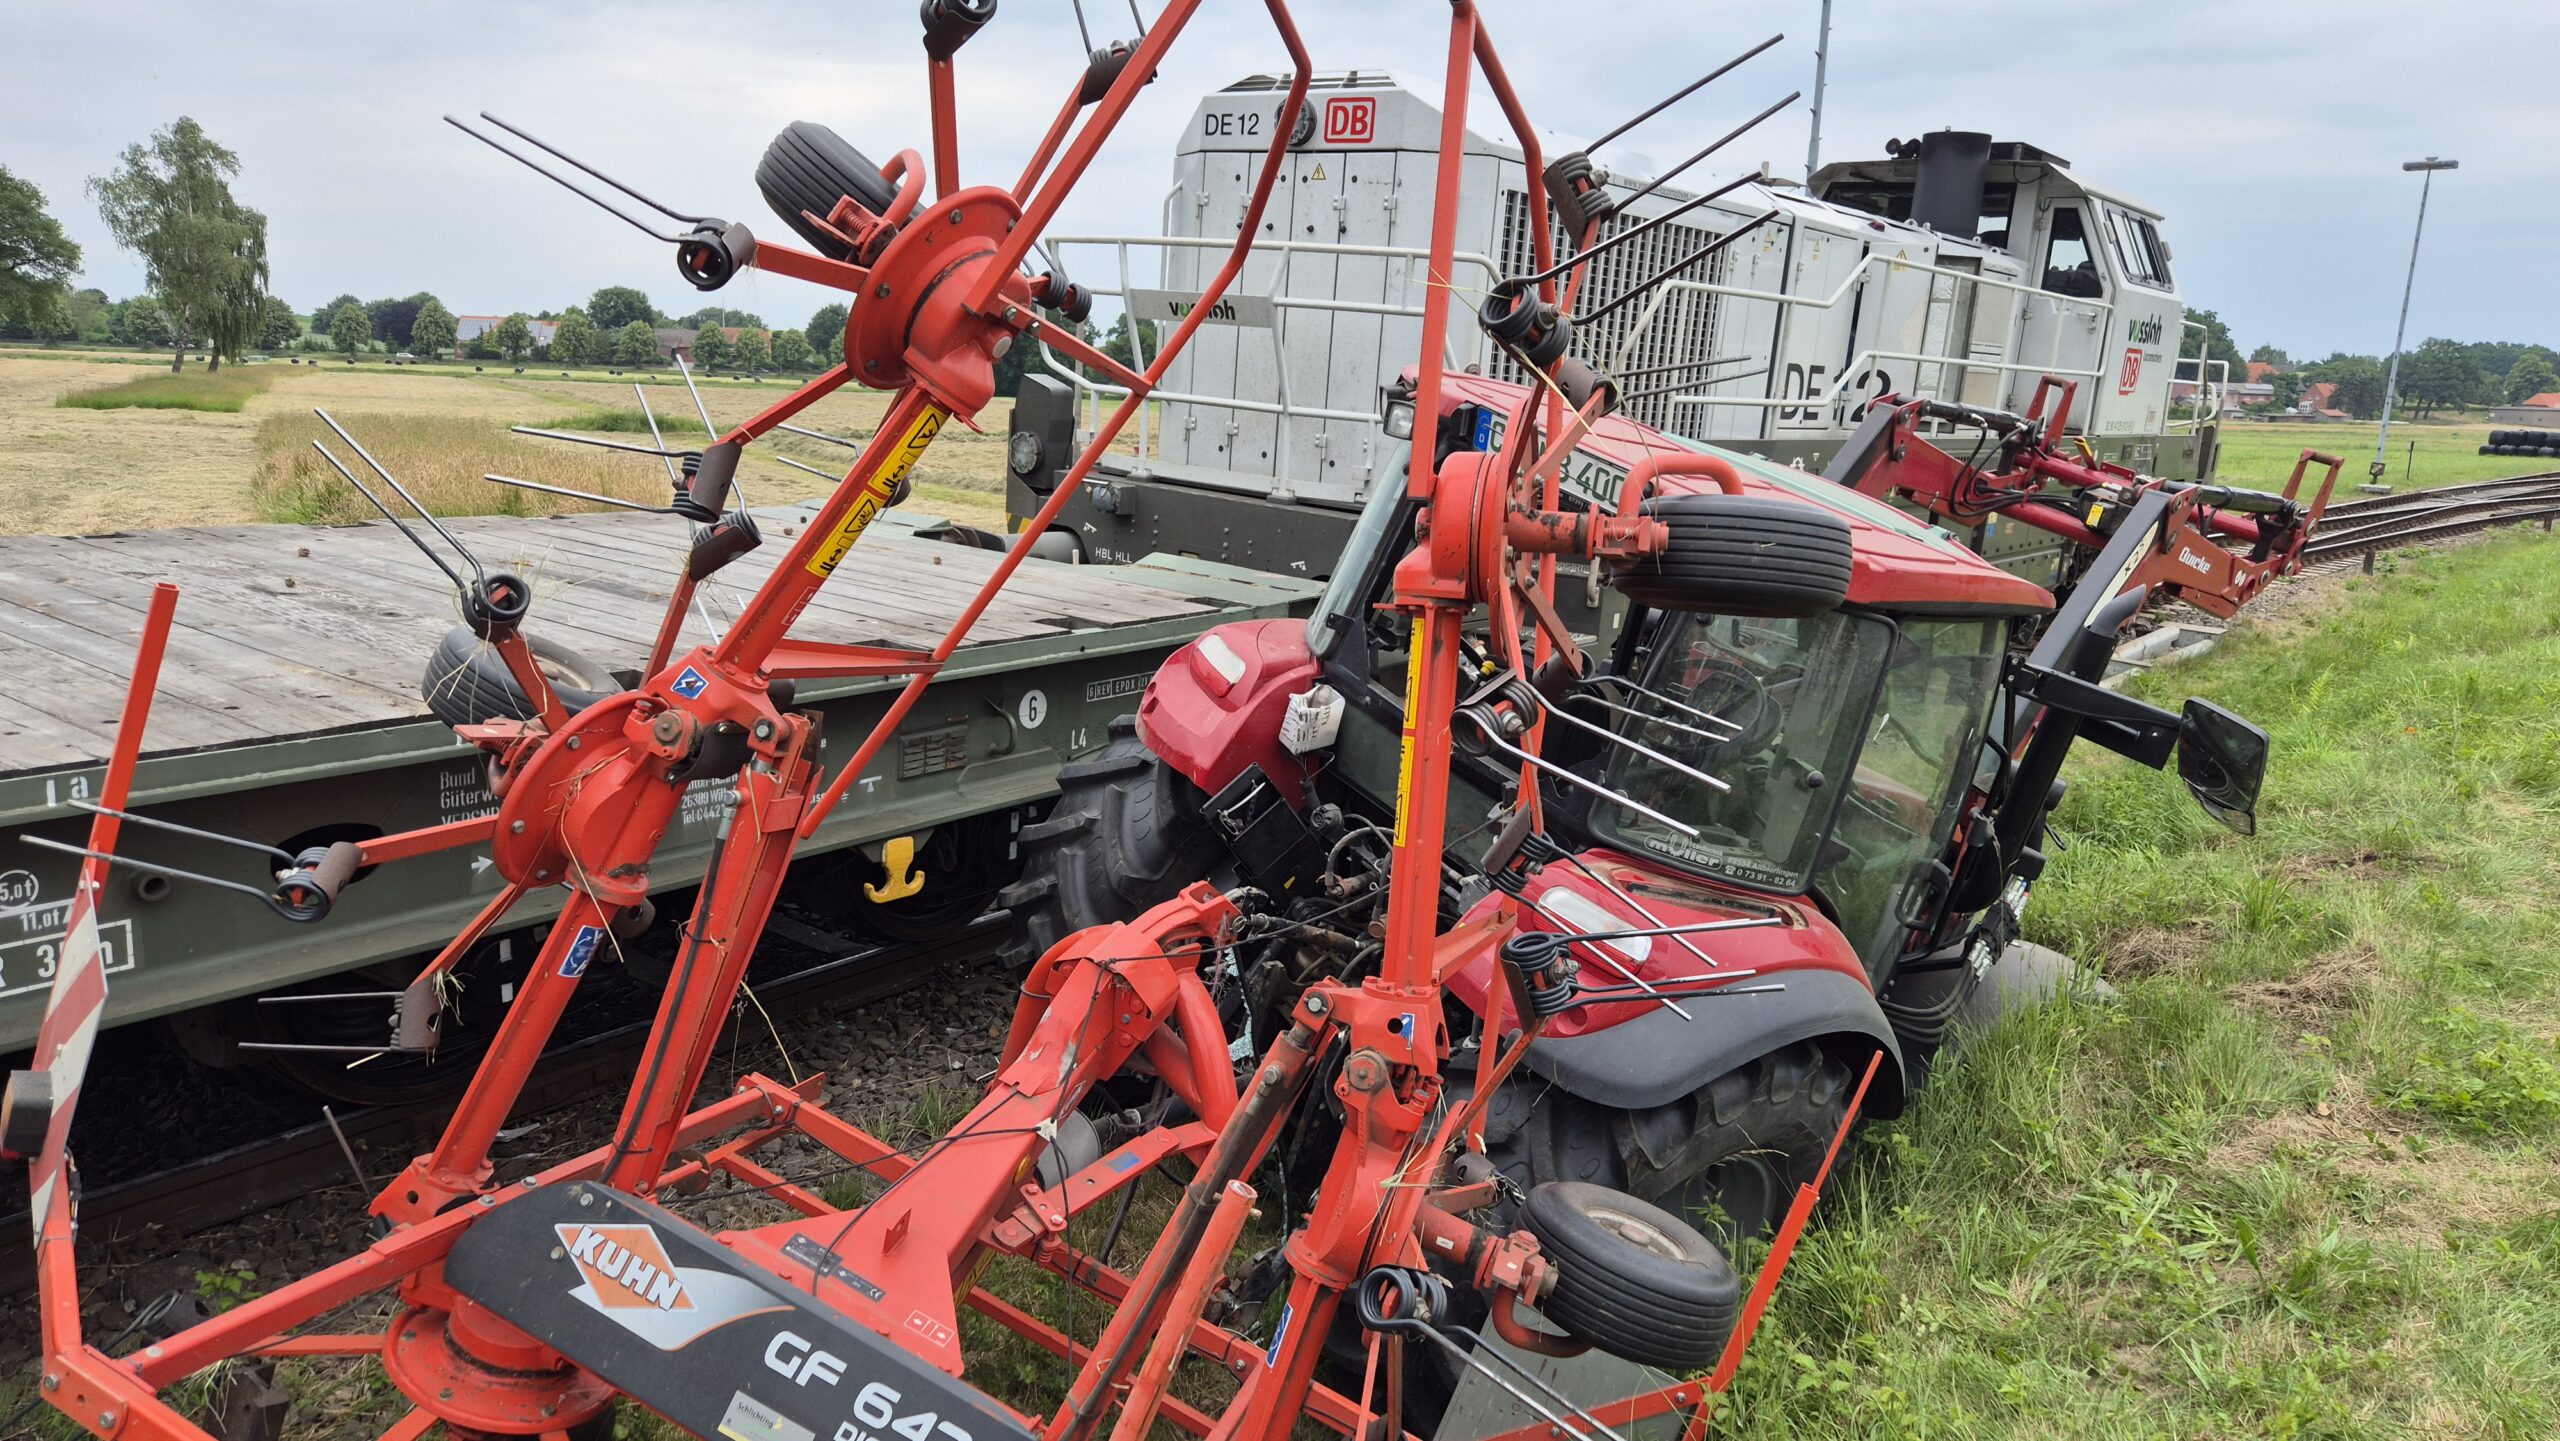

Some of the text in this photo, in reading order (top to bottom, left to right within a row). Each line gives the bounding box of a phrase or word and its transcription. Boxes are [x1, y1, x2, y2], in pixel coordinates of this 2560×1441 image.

[1204, 112, 1260, 136] DE 12
[1330, 104, 1369, 136] DB
[2128, 313, 2162, 345] vossloh
[1779, 362, 1826, 421] DE
[1478, 433, 1485, 443] D
[1095, 546, 1132, 564] HBL HLL
[2178, 546, 2211, 574] Quicke
[1097, 681, 1112, 697] REV
[1028, 695, 1038, 722] 6
[1071, 727, 1087, 750] L4
[440, 766, 476, 790] Bund
[1744, 870, 1755, 880] 73
[1756, 873, 1767, 883] 91
[1773, 877, 1784, 886] 82
[570, 1224, 684, 1311] KUHN
[764, 1330, 849, 1388] GF
[736, 1402, 775, 1431] Schlichting
